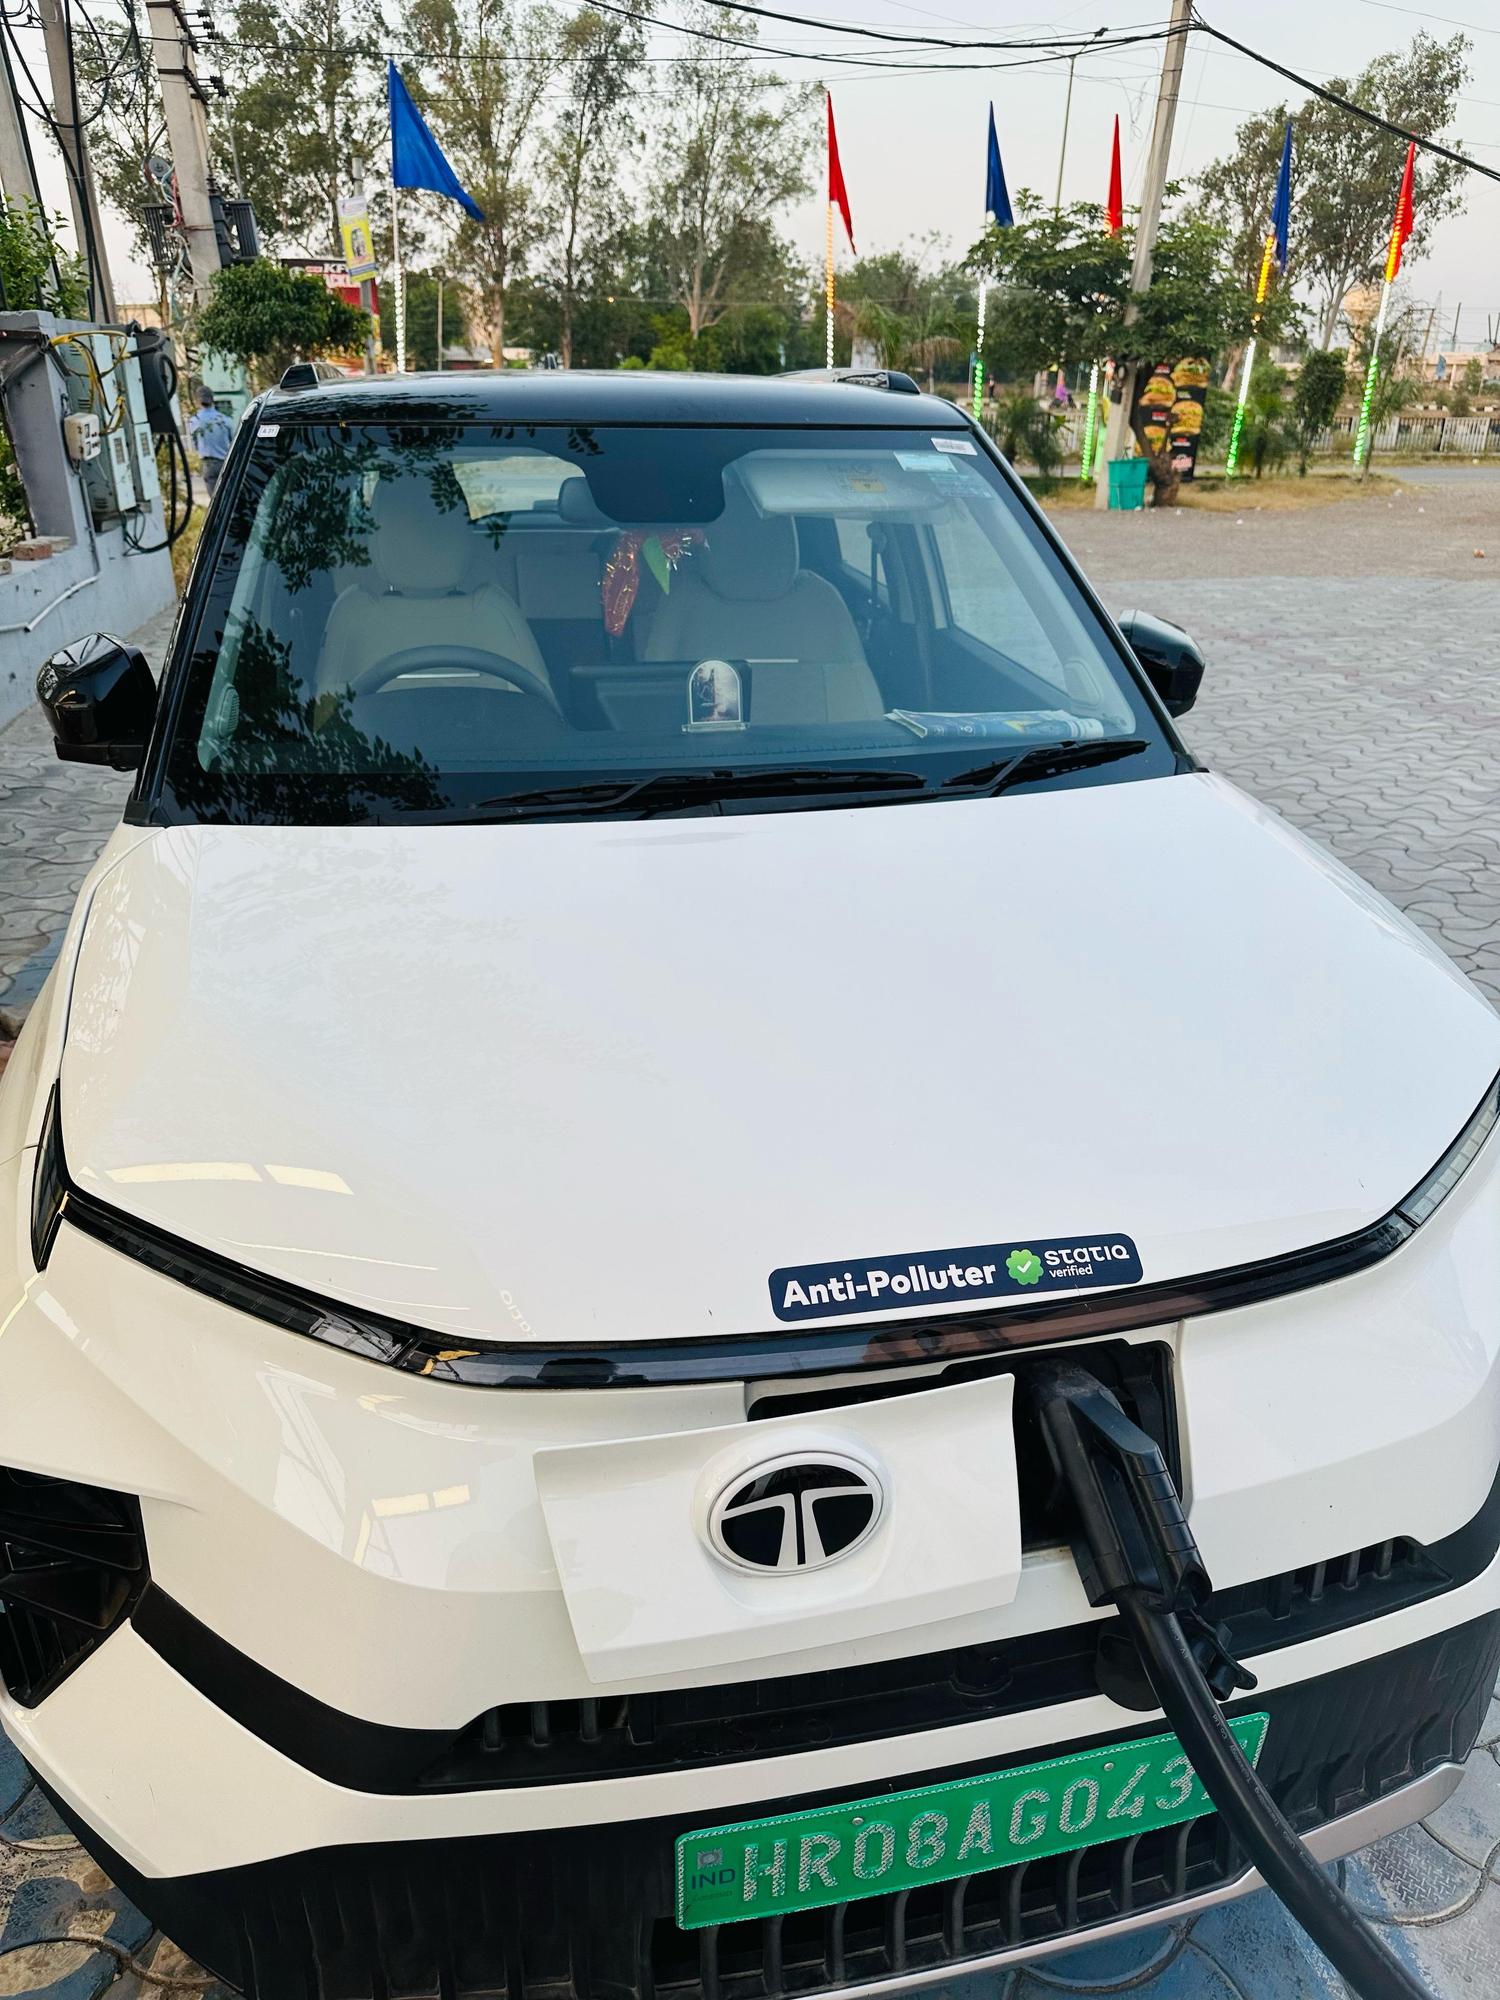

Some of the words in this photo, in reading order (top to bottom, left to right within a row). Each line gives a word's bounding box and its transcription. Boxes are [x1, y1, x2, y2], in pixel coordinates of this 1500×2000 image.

[324, 263, 348, 273] KF
[1049, 1263, 1093, 1278] verified
[782, 1263, 996, 1308] Anti-Polluter
[743, 1739, 1248, 1902] HR08AG043
[691, 1868, 735, 1889] IND
